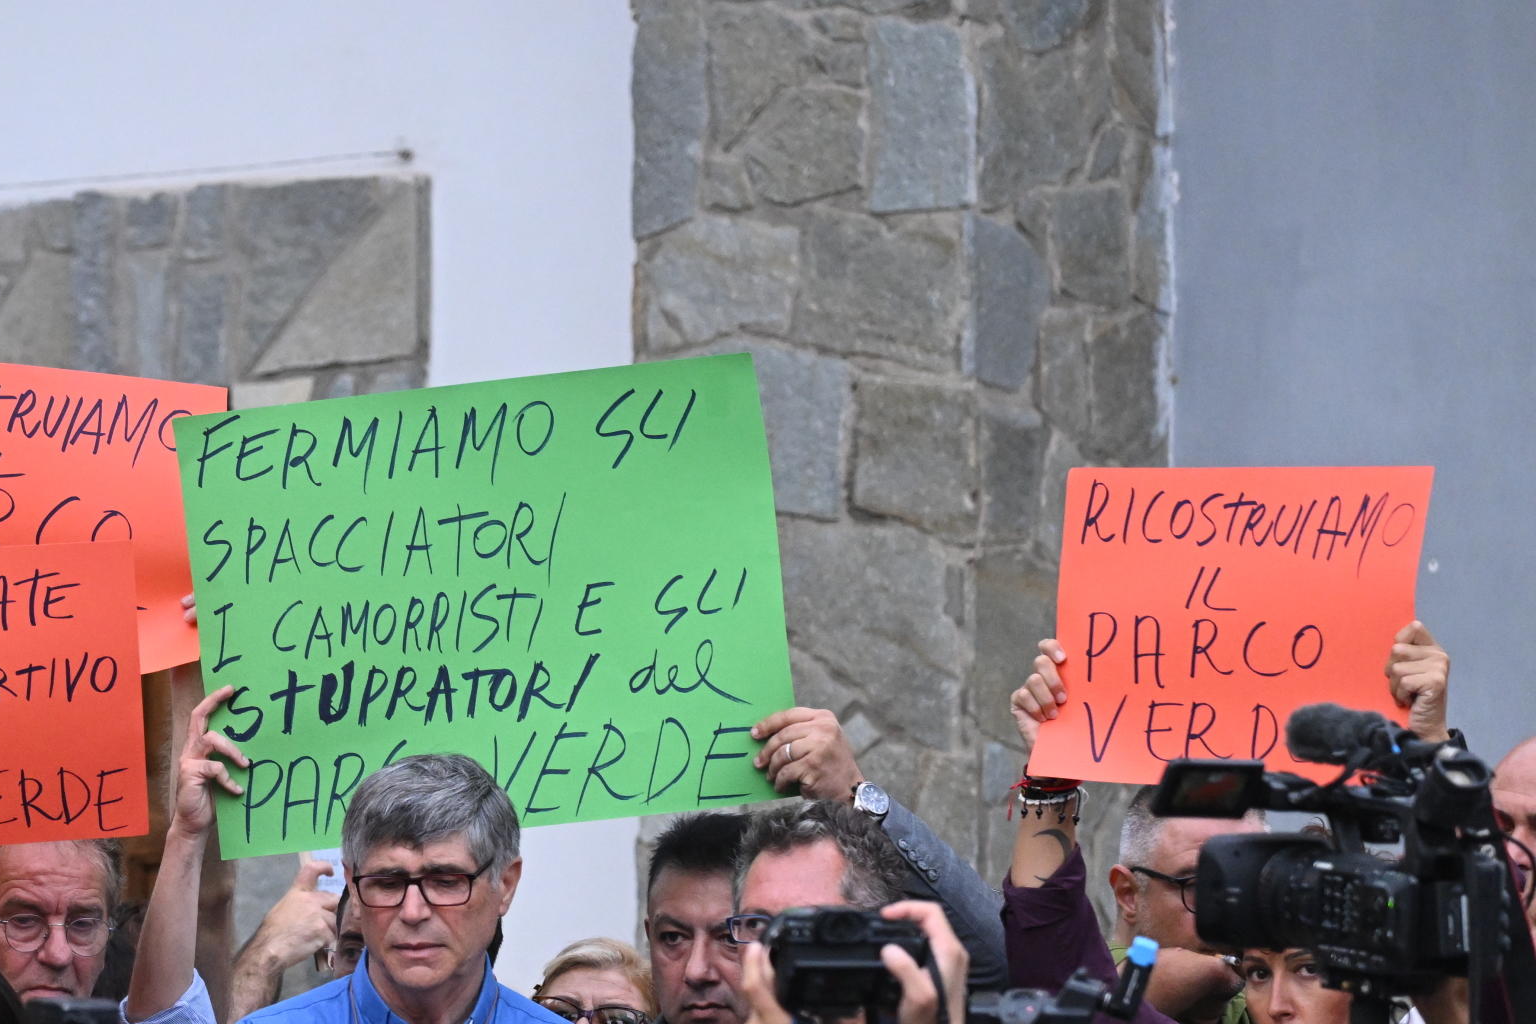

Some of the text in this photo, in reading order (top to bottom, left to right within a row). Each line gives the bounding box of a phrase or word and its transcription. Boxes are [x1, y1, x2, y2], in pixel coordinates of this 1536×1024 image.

[197, 388, 697, 494] FERMIAMO GLI
[202, 491, 567, 587] SPACCIATORI
[1080, 478, 1416, 579] RICOSTRUIAMO
[211, 567, 747, 673] I CAMORRISTI E GLI
[1185, 566, 1237, 611] IL
[222, 638, 753, 743] STUPRATORI del
[1086, 611, 1324, 688] PARCO
[244, 716, 755, 844] PAR VERDE
[1083, 695, 1280, 764] VERD
